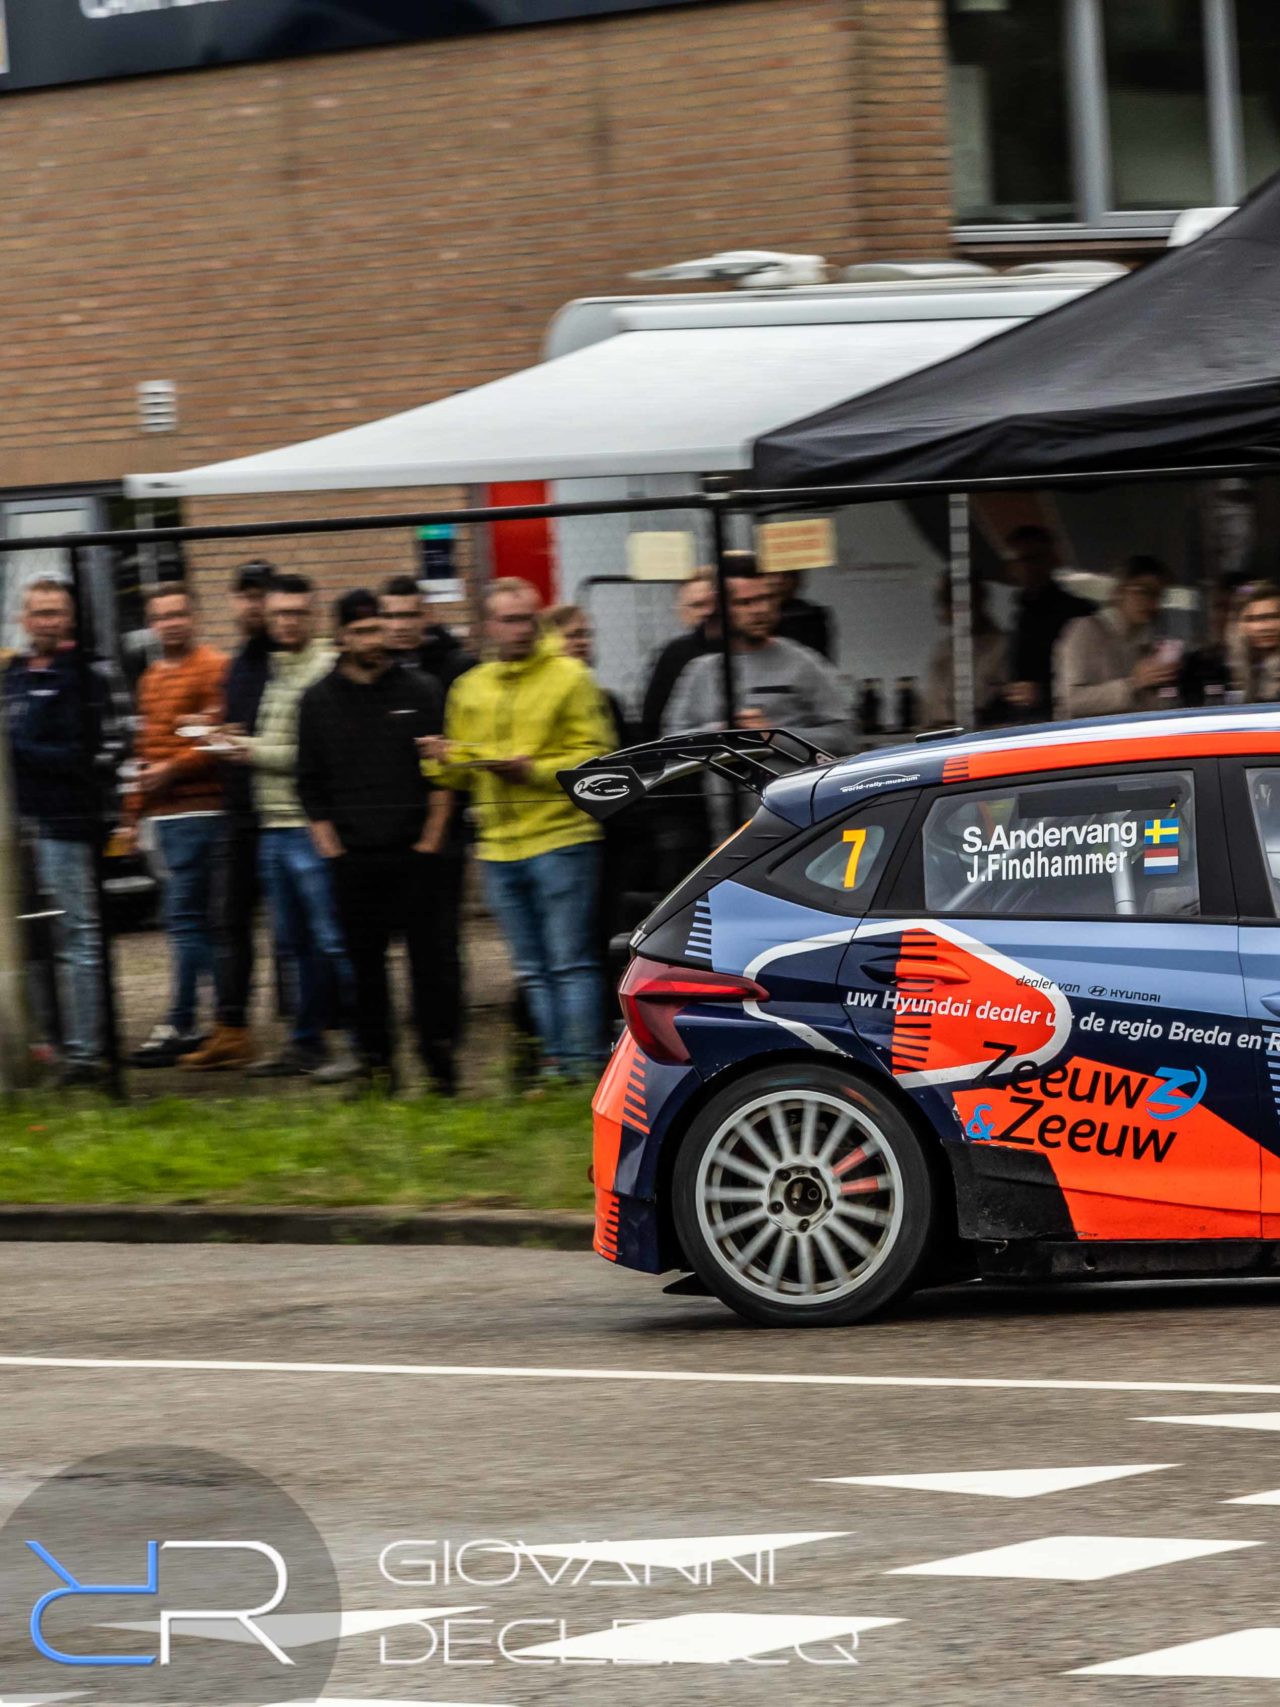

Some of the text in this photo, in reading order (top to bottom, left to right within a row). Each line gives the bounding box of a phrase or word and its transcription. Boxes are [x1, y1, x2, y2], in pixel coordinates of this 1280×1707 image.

[962, 821, 1138, 853] S.Andervang
[842, 829, 867, 888] 7
[967, 850, 1128, 882] J.Findhammer
[1016, 976, 1080, 993] dealer van
[1110, 989, 1161, 1002] HYUNDAI
[846, 991, 876, 1008] uw
[882, 991, 970, 1017] Hyundai
[975, 1001, 1041, 1024] dealer
[1079, 1012, 1105, 1032] de
[1109, 1019, 1163, 1041] regio
[1168, 1022, 1231, 1046] Breda
[1237, 1034, 1262, 1050] en
[972, 1040, 1149, 1109] Zeeuw
[965, 1096, 1177, 1163] & Zeeuw
